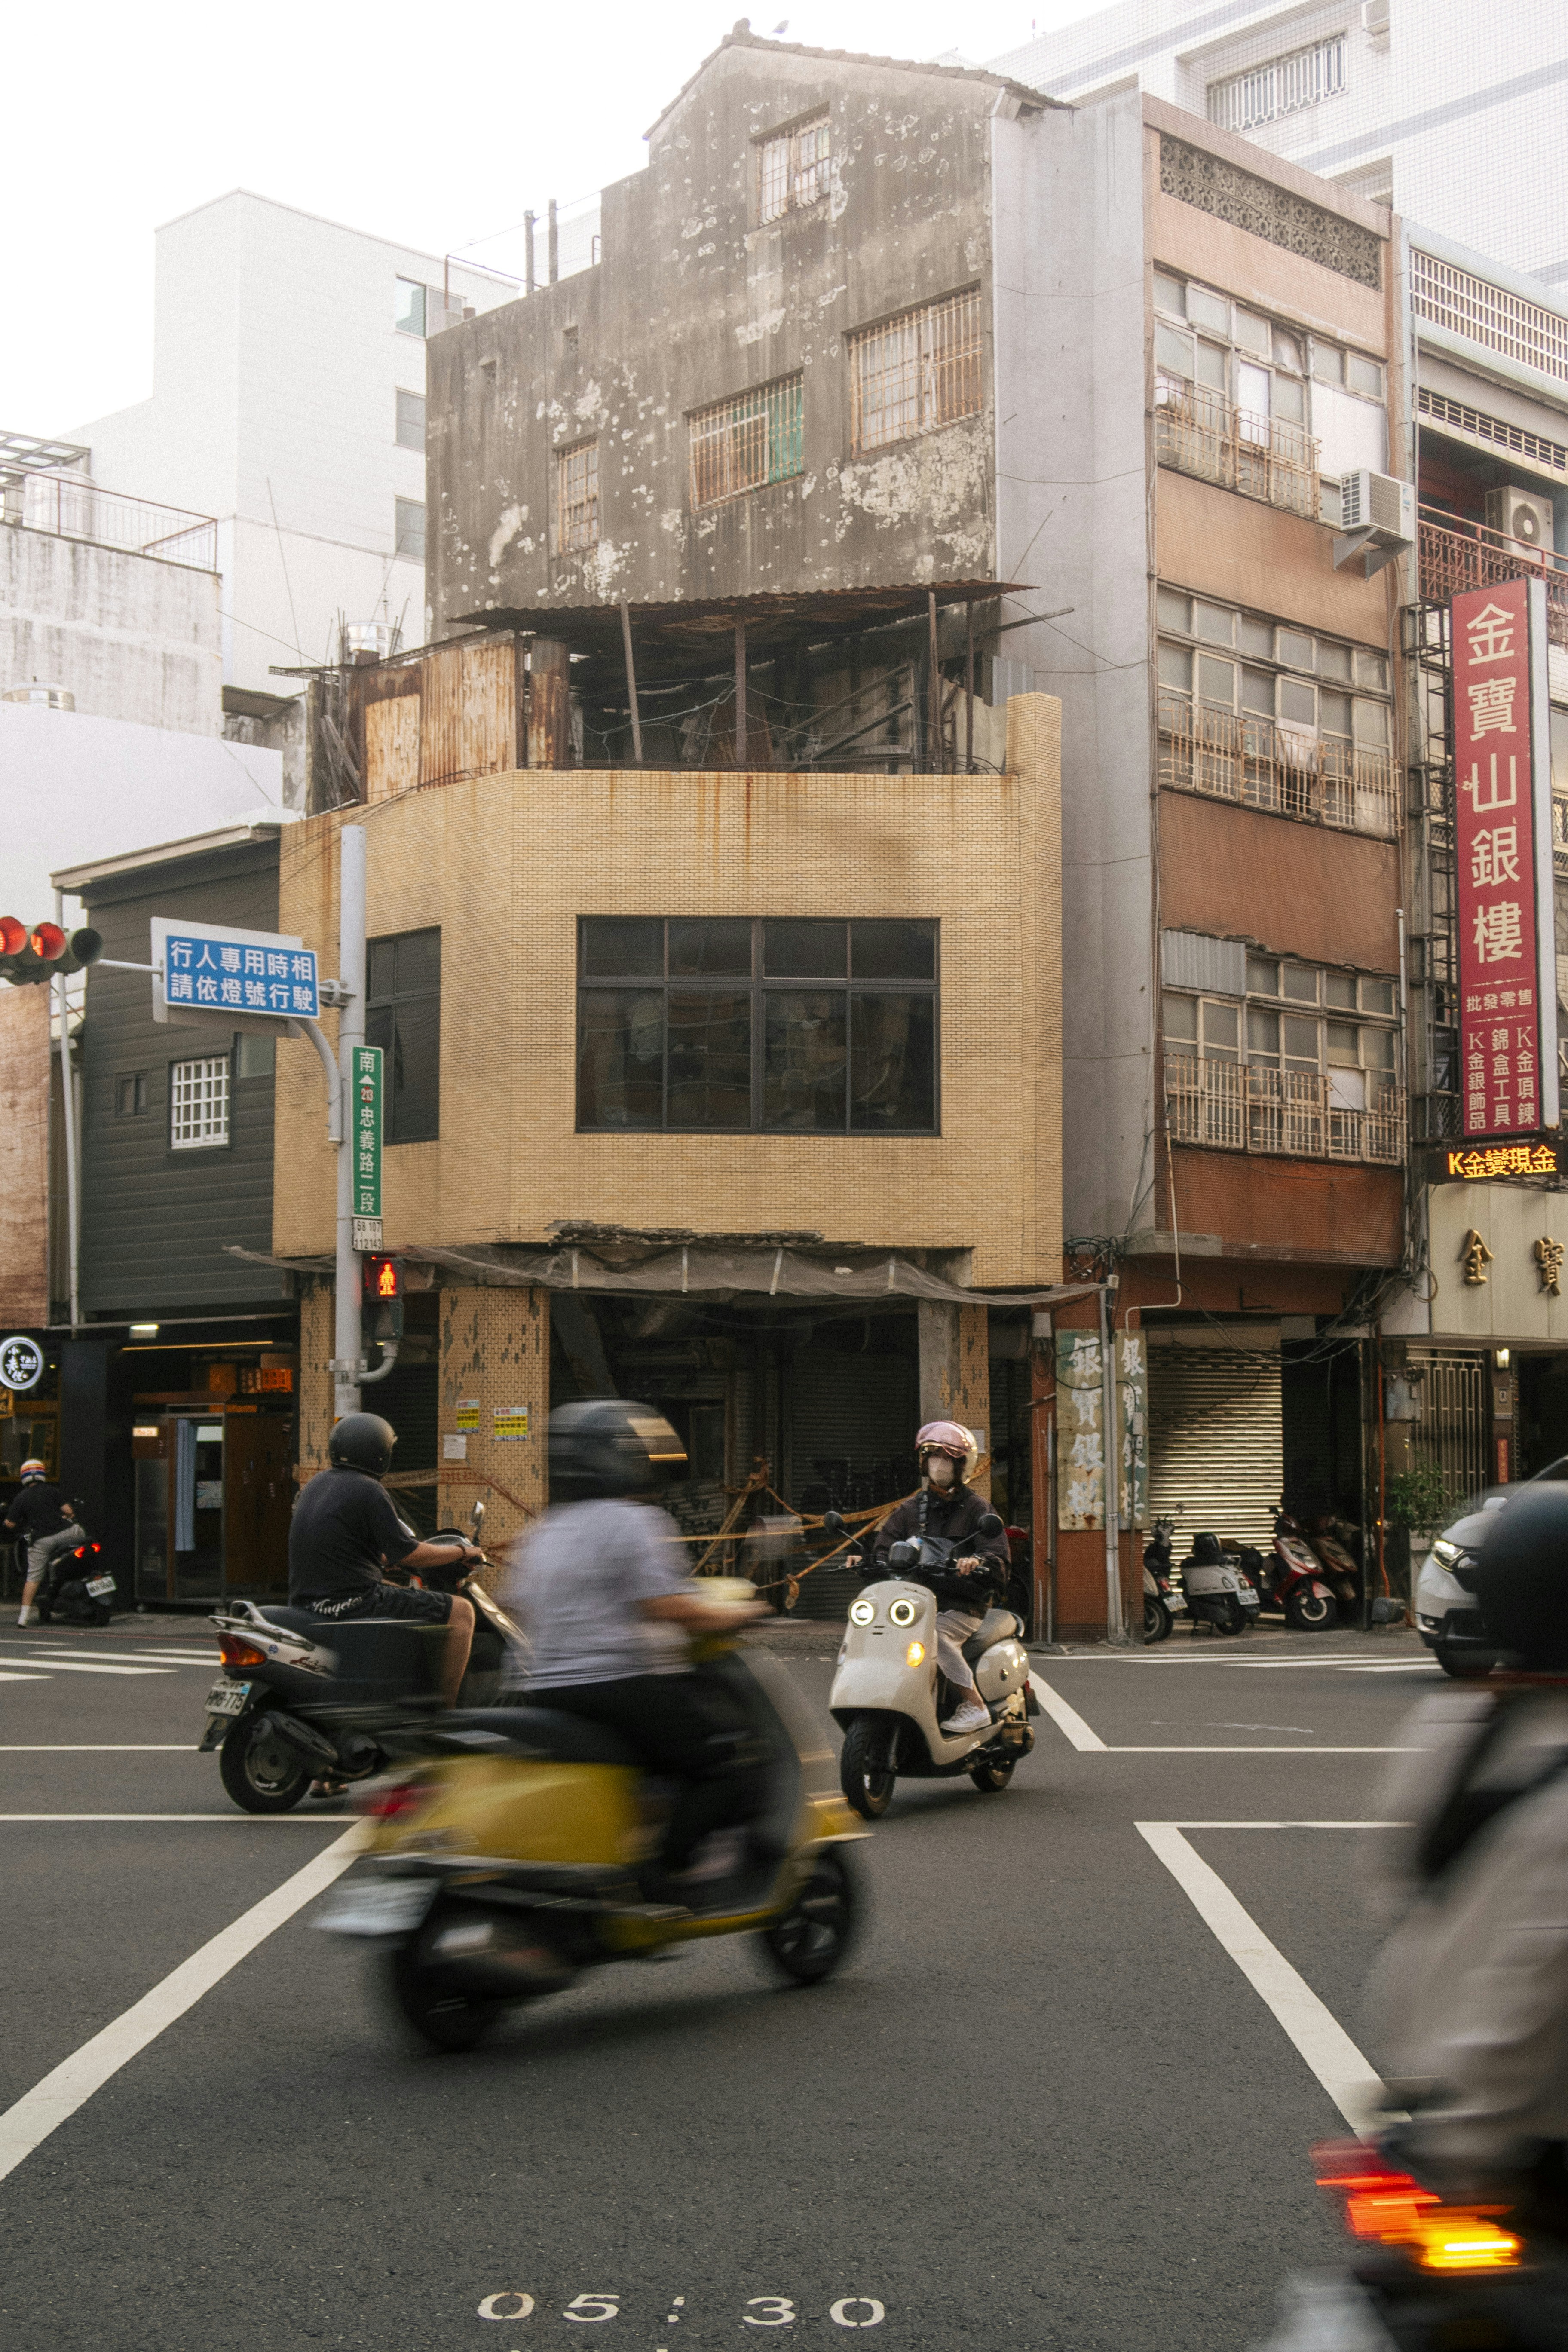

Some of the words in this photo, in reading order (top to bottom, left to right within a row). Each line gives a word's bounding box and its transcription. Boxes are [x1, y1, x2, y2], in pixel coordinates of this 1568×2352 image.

[1466, 603, 1523, 963] 金寶山銀樓
[170, 940, 312, 982] 行人專用時相
[170, 972, 313, 1011] 請依燈號行駛
[1466, 989, 1533, 1013] 批發零售
[359, 1051, 375, 1073] 南
[1467, 1032, 1486, 1130] K金銀飾品
[1491, 1028, 1511, 1127] 錦盒工具
[1516, 1026, 1535, 1126] K金項鍊
[359, 1106, 375, 1213] 忠義路二段
[1448, 1144, 1557, 1178] K金變現金
